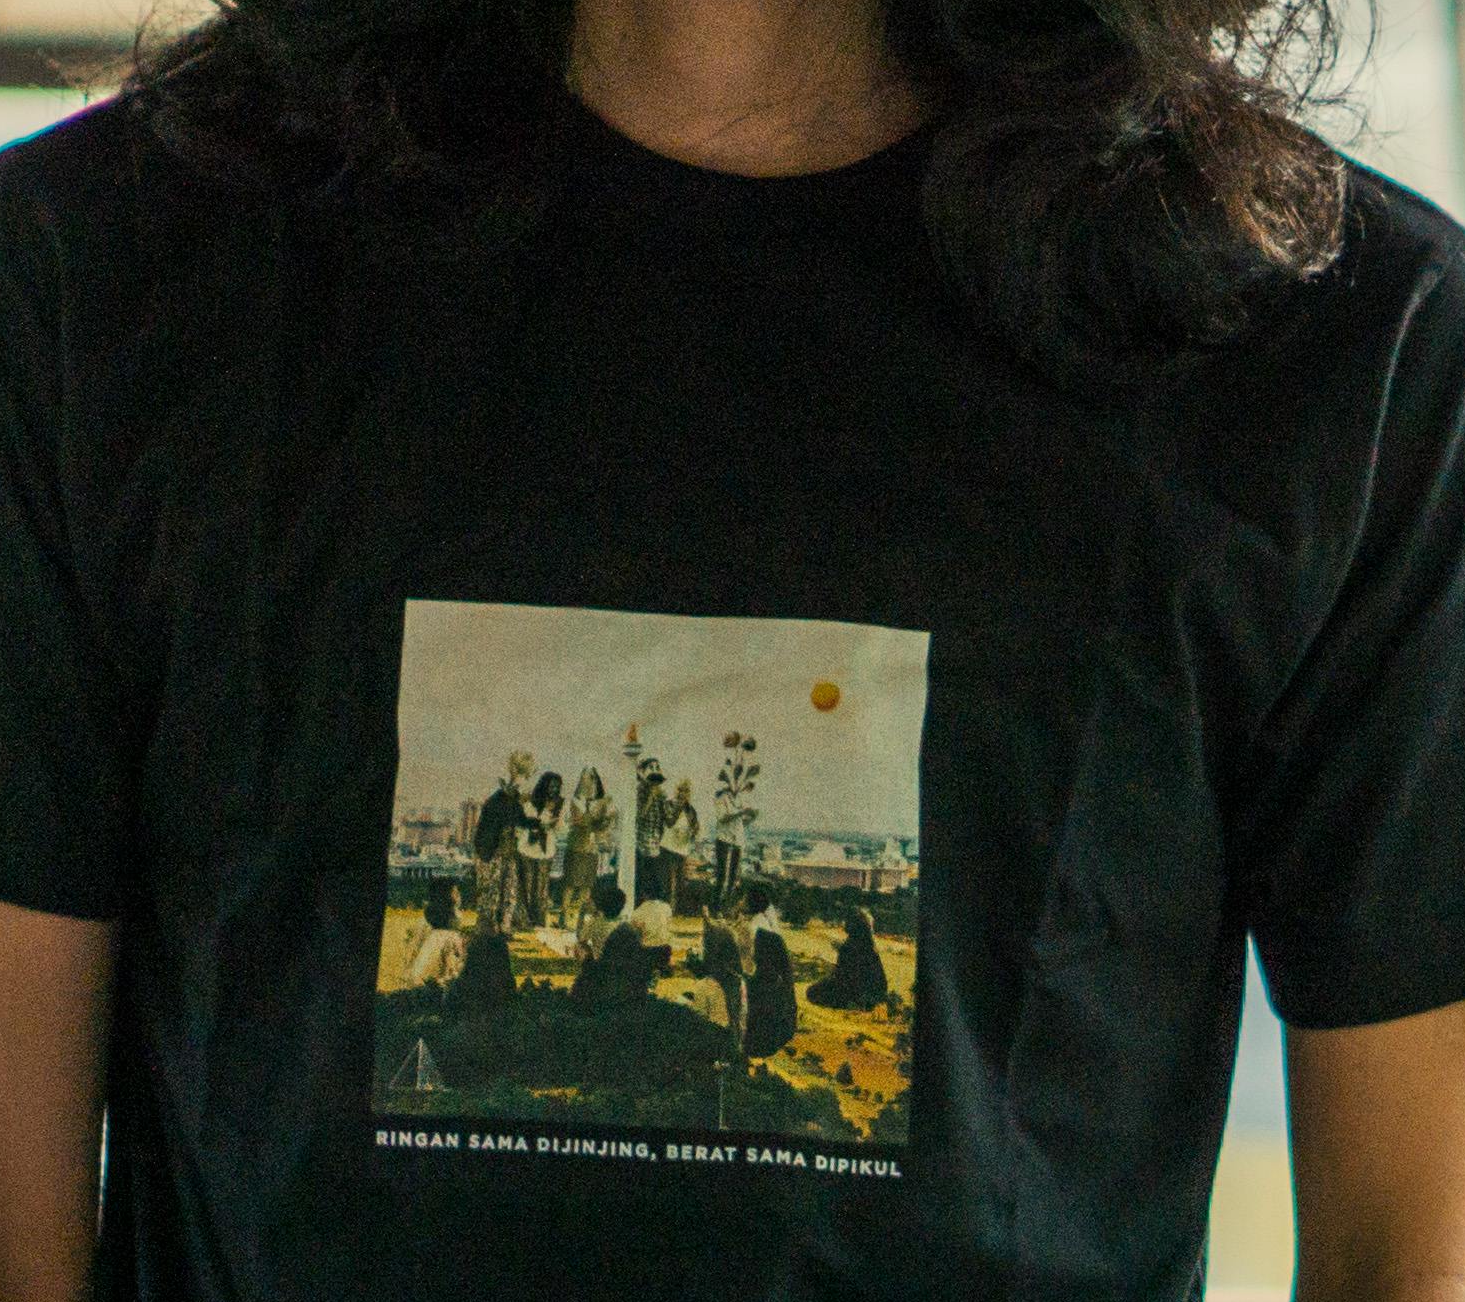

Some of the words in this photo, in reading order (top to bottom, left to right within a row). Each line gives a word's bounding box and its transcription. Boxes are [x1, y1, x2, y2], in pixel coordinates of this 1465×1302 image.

[375, 1130, 459, 1148] RINGAN
[468, 1133, 529, 1151] SAMA
[536, 1137, 657, 1161] DIJINJING,
[666, 1144, 737, 1162] BERAT
[746, 1147, 807, 1168] SAMA
[815, 1154, 902, 1178] DIPIKUL
